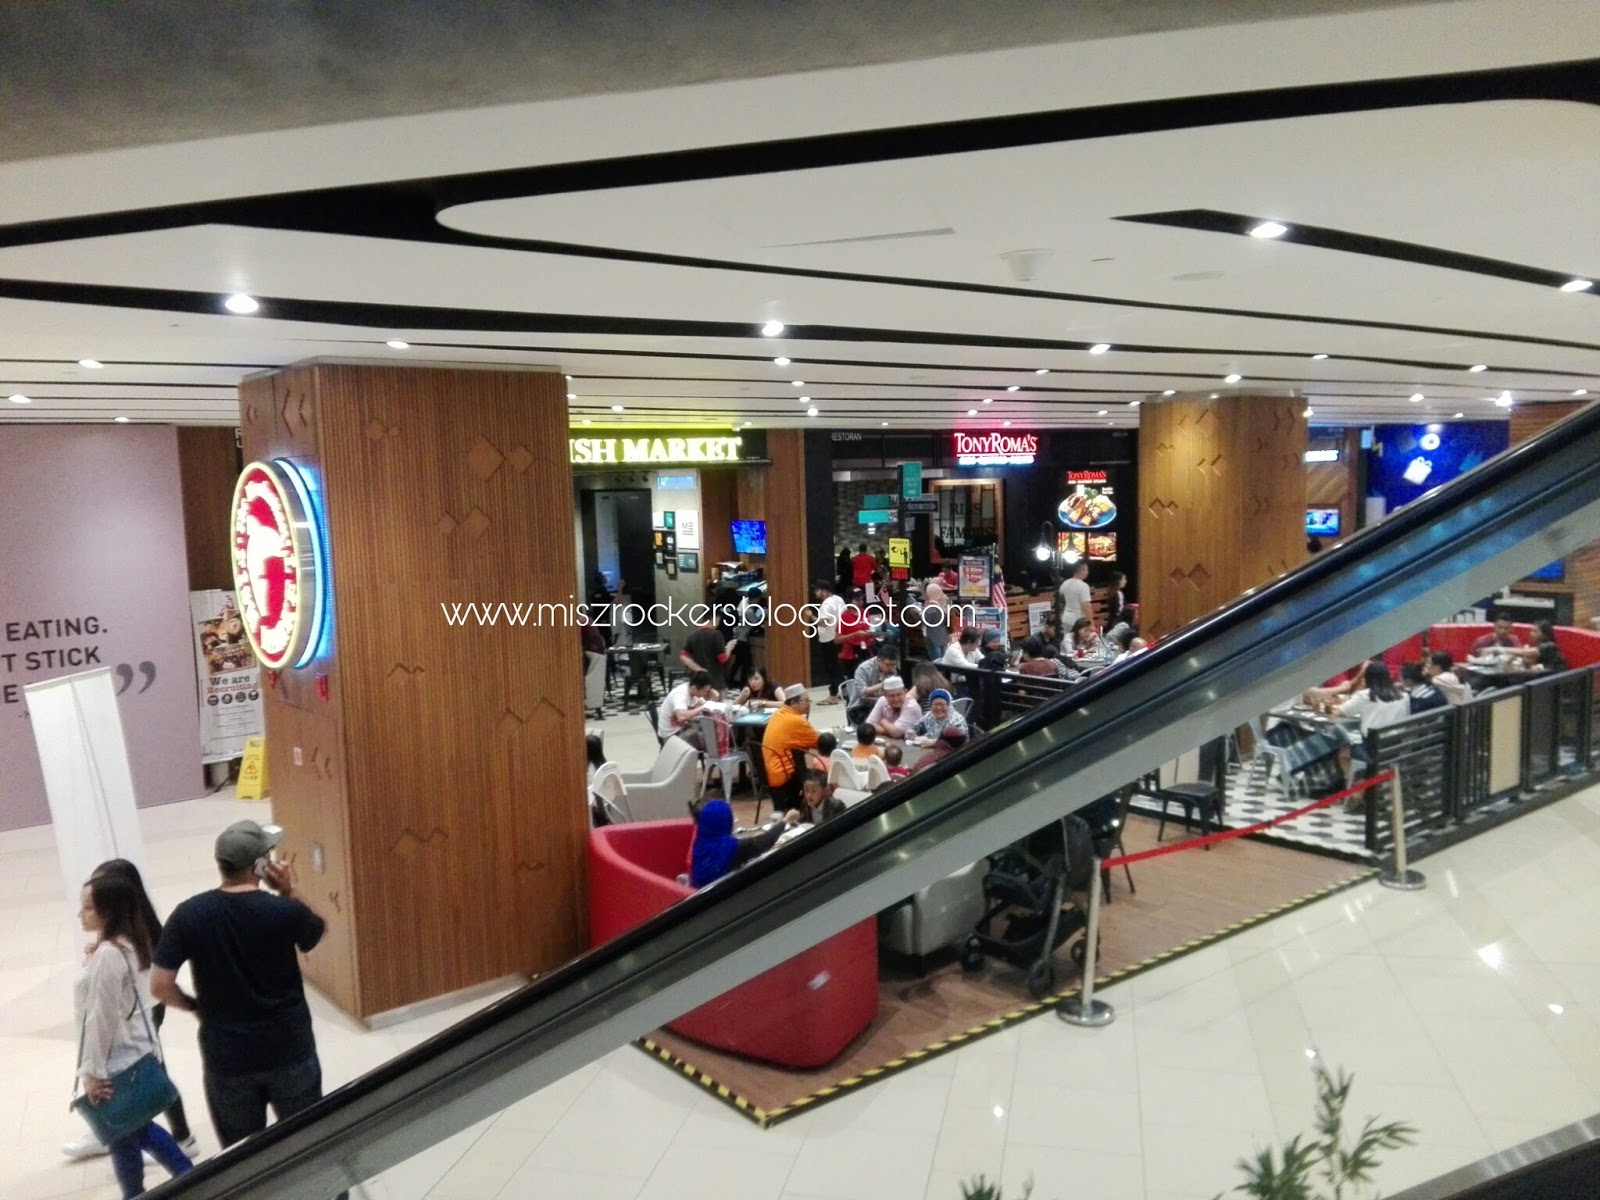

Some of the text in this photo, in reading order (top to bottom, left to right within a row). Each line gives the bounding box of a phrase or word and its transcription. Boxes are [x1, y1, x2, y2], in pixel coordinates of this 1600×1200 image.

[621, 436, 742, 463] MARKET
[6, 616, 108, 642] EATING.
[25, 645, 101, 670] STICK
[209, 675, 250, 685] We are
